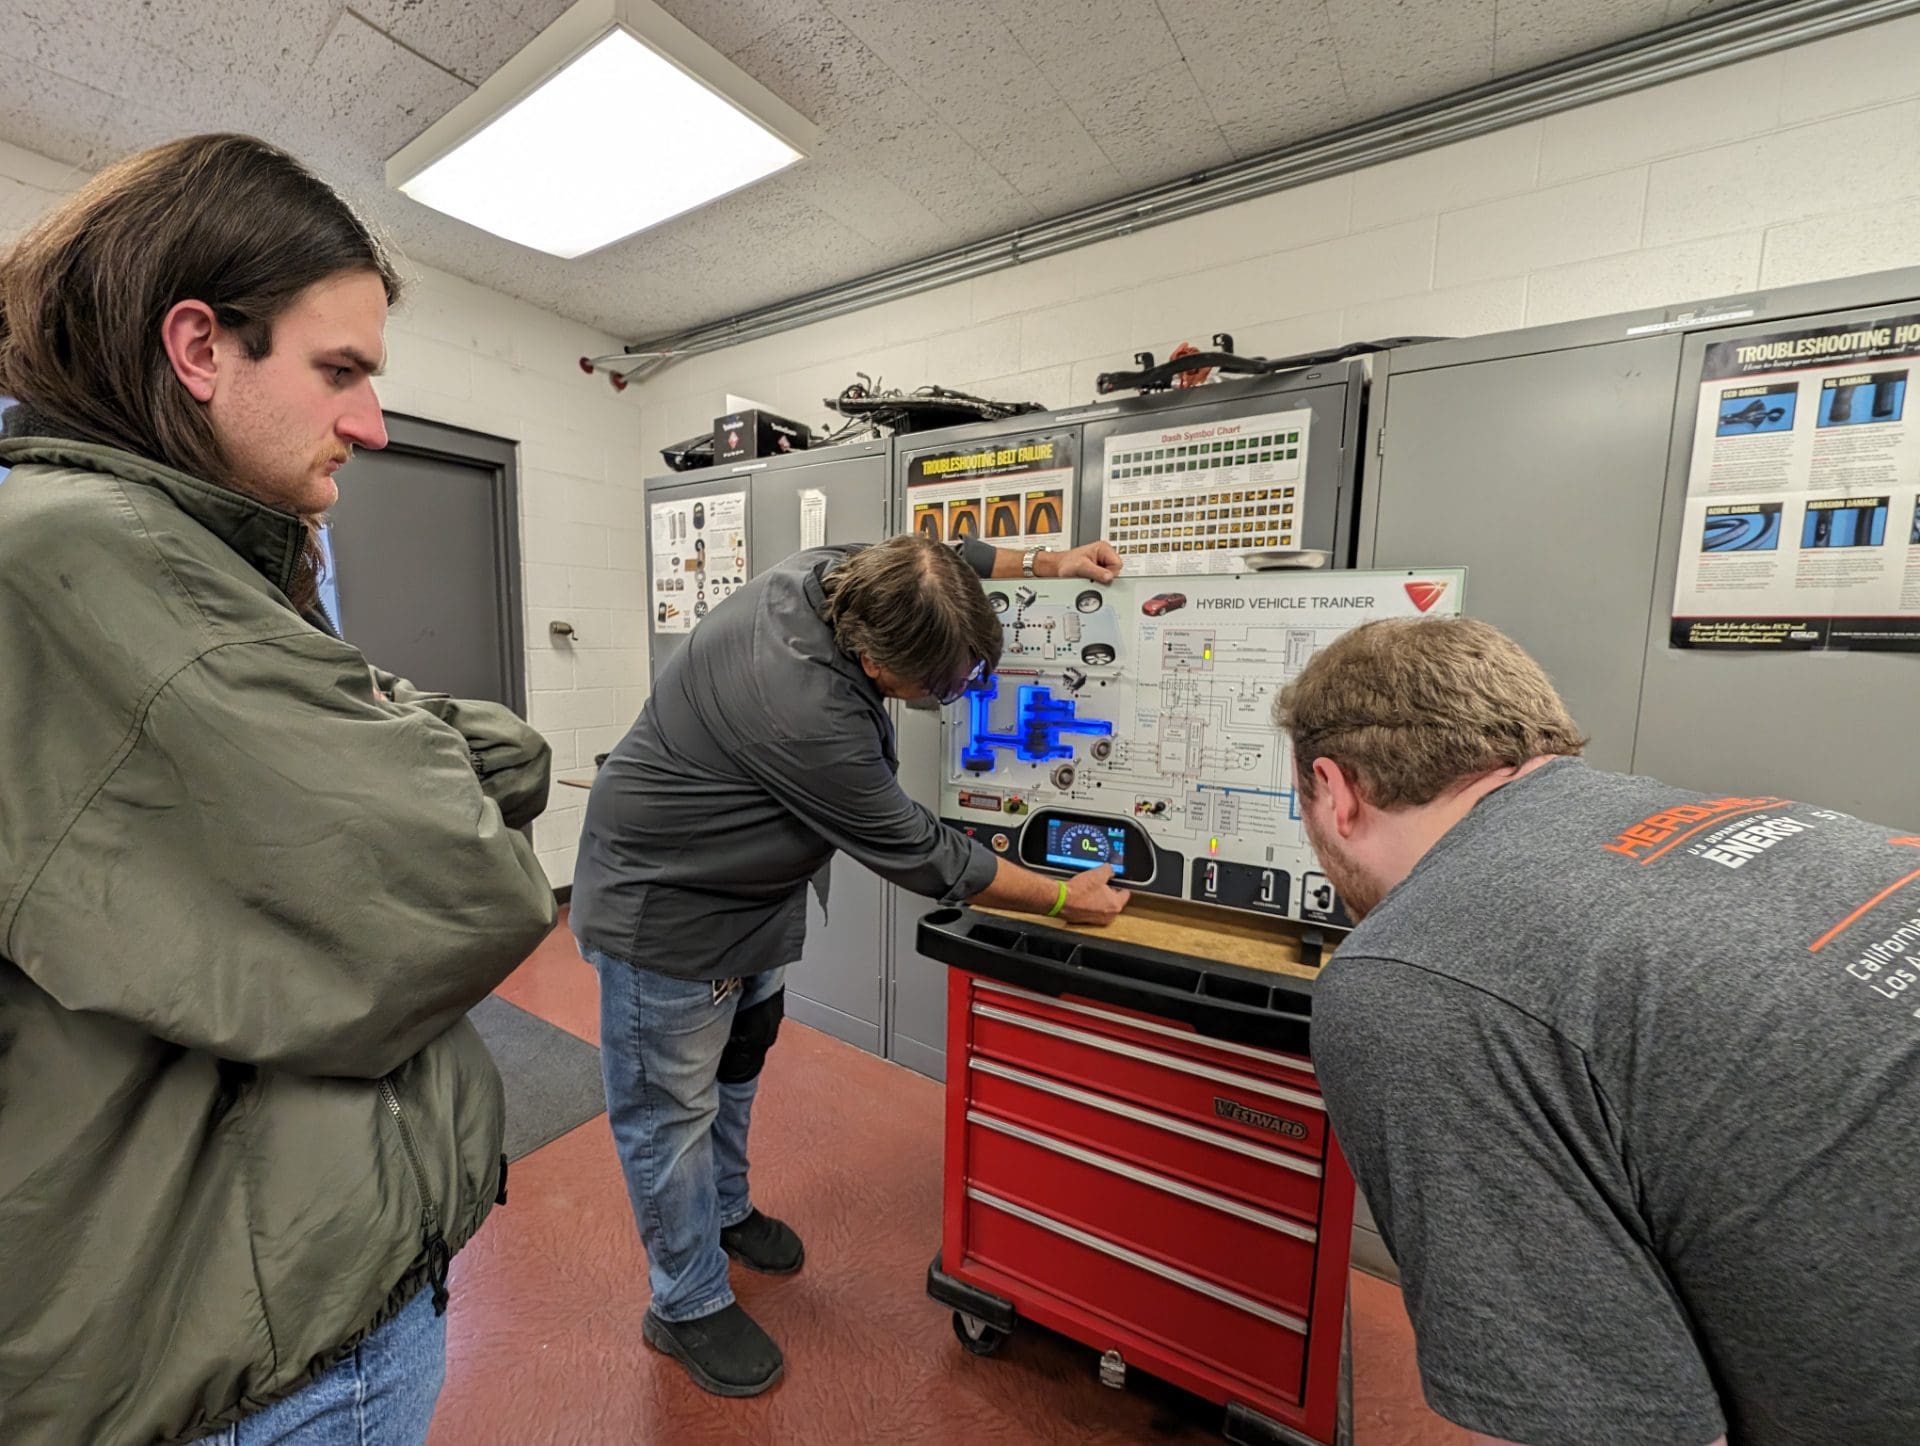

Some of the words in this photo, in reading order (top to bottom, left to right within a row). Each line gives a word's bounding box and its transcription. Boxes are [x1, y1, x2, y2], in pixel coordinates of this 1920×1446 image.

[1736, 328, 1891, 364] TROUBLESHOOTING
[1824, 379, 1838, 388] OIL
[1839, 375, 1872, 387] DAMAGE
[1738, 386, 1767, 397] DAMAGE
[1161, 433, 1182, 444] Dash
[1183, 430, 1215, 441] Symbol
[1216, 425, 1241, 436] Chart
[922, 452, 996, 475] TROUBLESHOOTING
[997, 449, 1018, 466] BELT
[1018, 444, 1054, 463] FAILURE
[1730, 504, 1760, 514] DAMAGE
[1807, 499, 1844, 510] ABRASION
[1846, 497, 1879, 508] DAMAGE
[1196, 598, 1244, 610] HYBRID
[1249, 597, 1307, 609] VEHICLE
[1312, 595, 1374, 608] TRAINER
[1704, 817, 1759, 844] DEPARTMENT
[1081, 838, 1090, 851] 0
[1700, 816, 1815, 869] ENERGY
[1869, 969, 1917, 999] Los
[1215, 1099, 1304, 1137] WESTWARD
